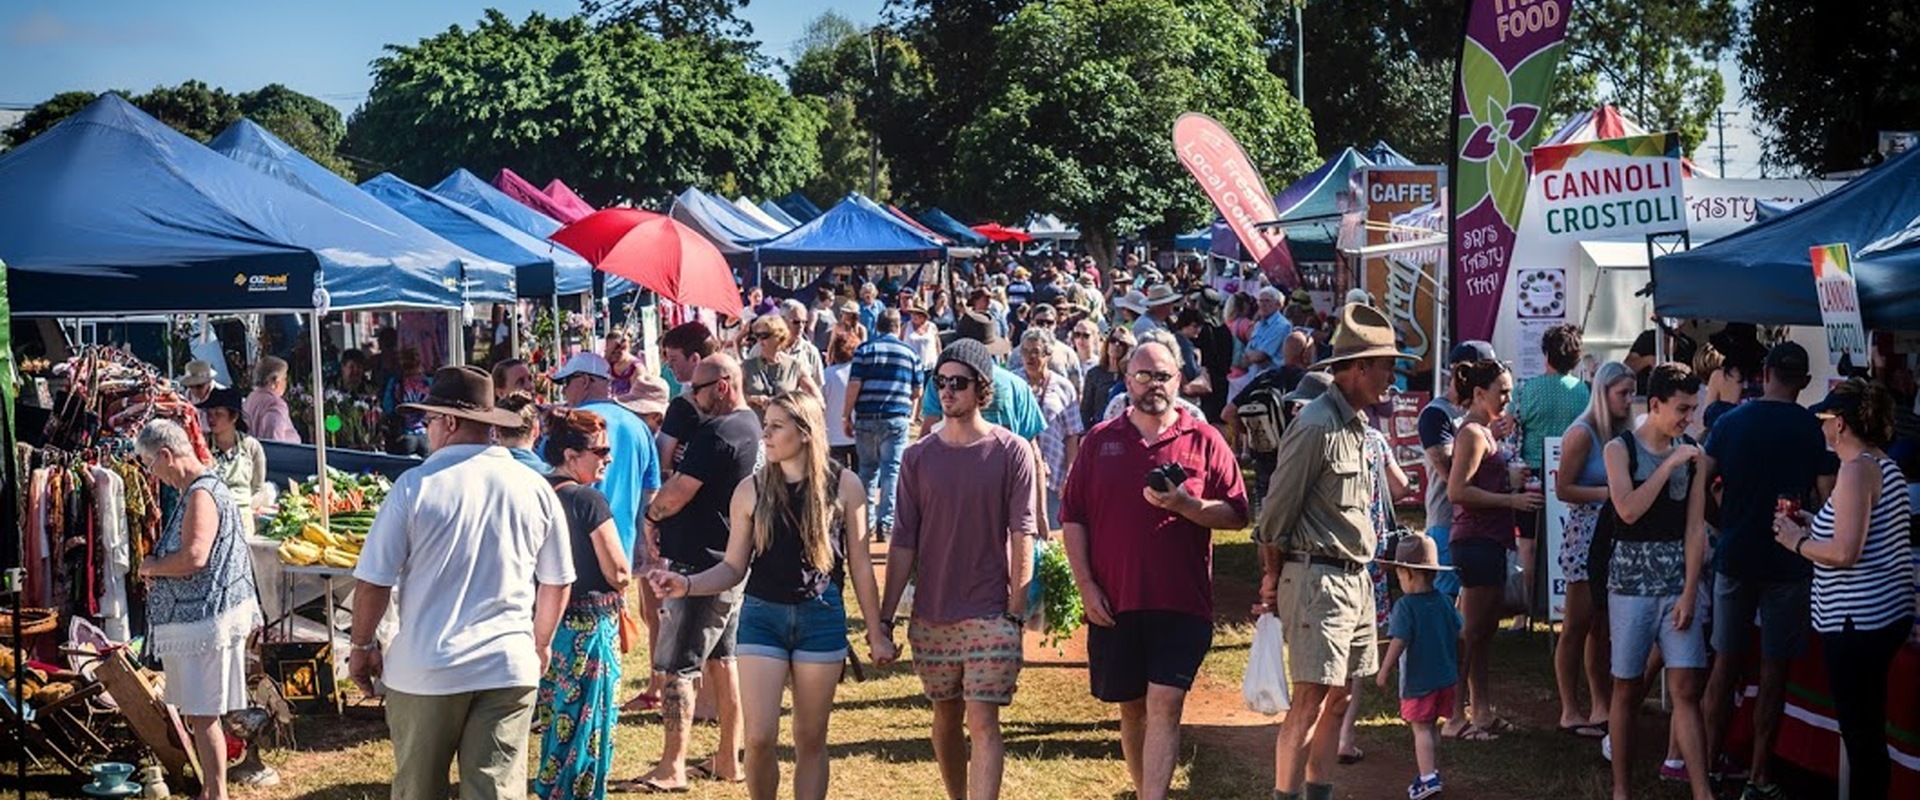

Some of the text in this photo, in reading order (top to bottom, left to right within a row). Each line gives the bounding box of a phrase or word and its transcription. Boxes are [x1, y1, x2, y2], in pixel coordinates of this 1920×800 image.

[1497, 0, 1560, 43] FOOD
[1183, 140, 1227, 192] Local
[1543, 161, 1671, 201] CANNOLI
[1371, 182, 1433, 203] CAFFE
[1685, 195, 1758, 222] ASTY
[1546, 195, 1679, 234] CROSTOLI
[1460, 246, 1505, 274] TASTY
[1466, 272, 1499, 296] THAI
